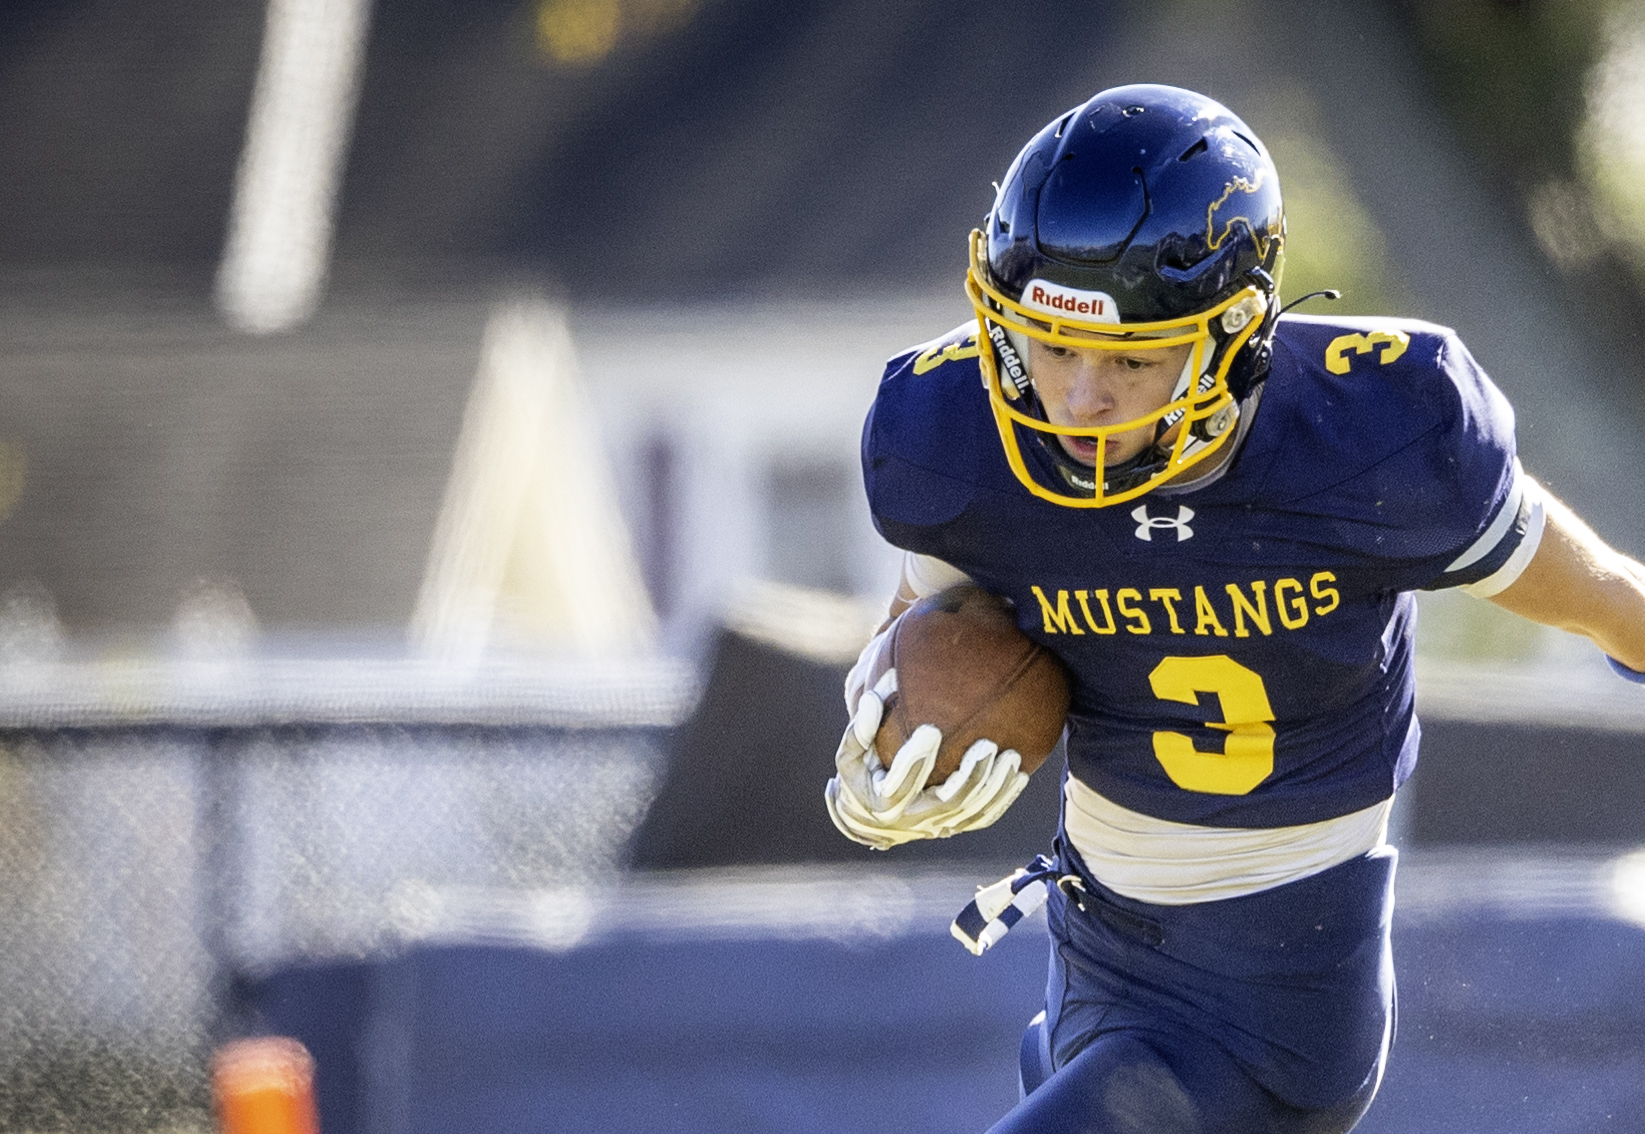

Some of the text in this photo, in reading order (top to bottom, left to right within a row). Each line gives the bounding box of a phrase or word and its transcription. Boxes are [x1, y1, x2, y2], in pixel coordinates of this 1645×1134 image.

[1032, 286, 1104, 315] Riddell
[991, 325, 1030, 390] Riddell
[1325, 329, 1410, 375] 3
[1163, 373, 1215, 427] Riell
[1031, 571, 1340, 638] MUSTANGS
[1148, 655, 1276, 795] 3
